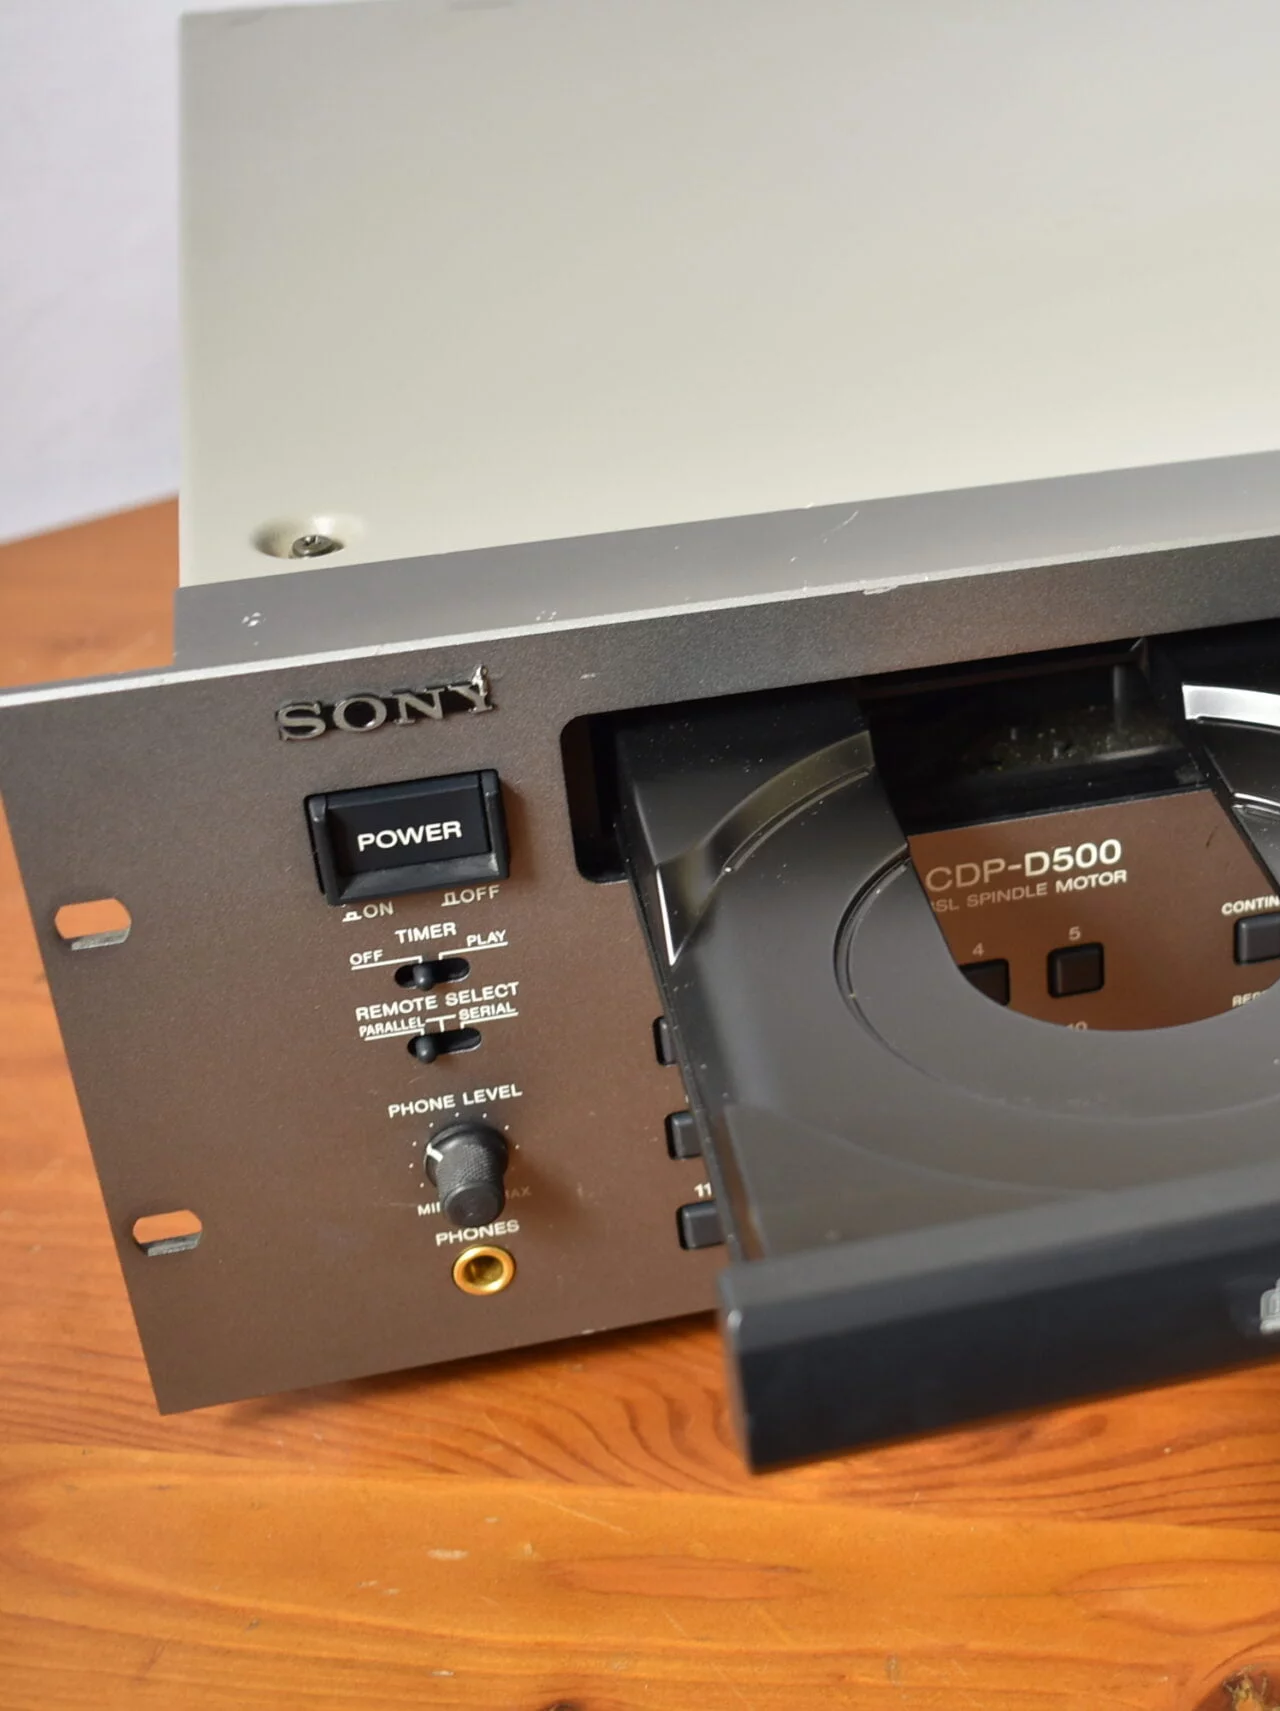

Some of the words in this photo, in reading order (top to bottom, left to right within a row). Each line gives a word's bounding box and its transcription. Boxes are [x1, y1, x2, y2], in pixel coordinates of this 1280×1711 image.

[275, 664, 497, 741] SONY
[357, 820, 462, 852] POWER
[924, 838, 1123, 893] CDP-D500
[459, 884, 501, 905] OFF
[966, 882, 1048, 908] SPINDLE
[1055, 869, 1128, 894] MOTOR
[362, 901, 394, 920] ON
[394, 921, 457, 945] TIMER
[466, 929, 507, 949] PLAY
[1068, 926, 1081, 940] 5
[349, 949, 384, 967] OFF
[971, 942, 985, 957] 4
[355, 995, 439, 1022] REMOTE
[444, 981, 520, 1007] SELECT
[359, 1016, 426, 1038] PARALLEL
[458, 1002, 517, 1022] SERIAL
[387, 1094, 456, 1118] PHONE
[462, 1083, 523, 1106] LEVEL
[694, 1182, 713, 1198] 11
[435, 1219, 520, 1246] PHONES
